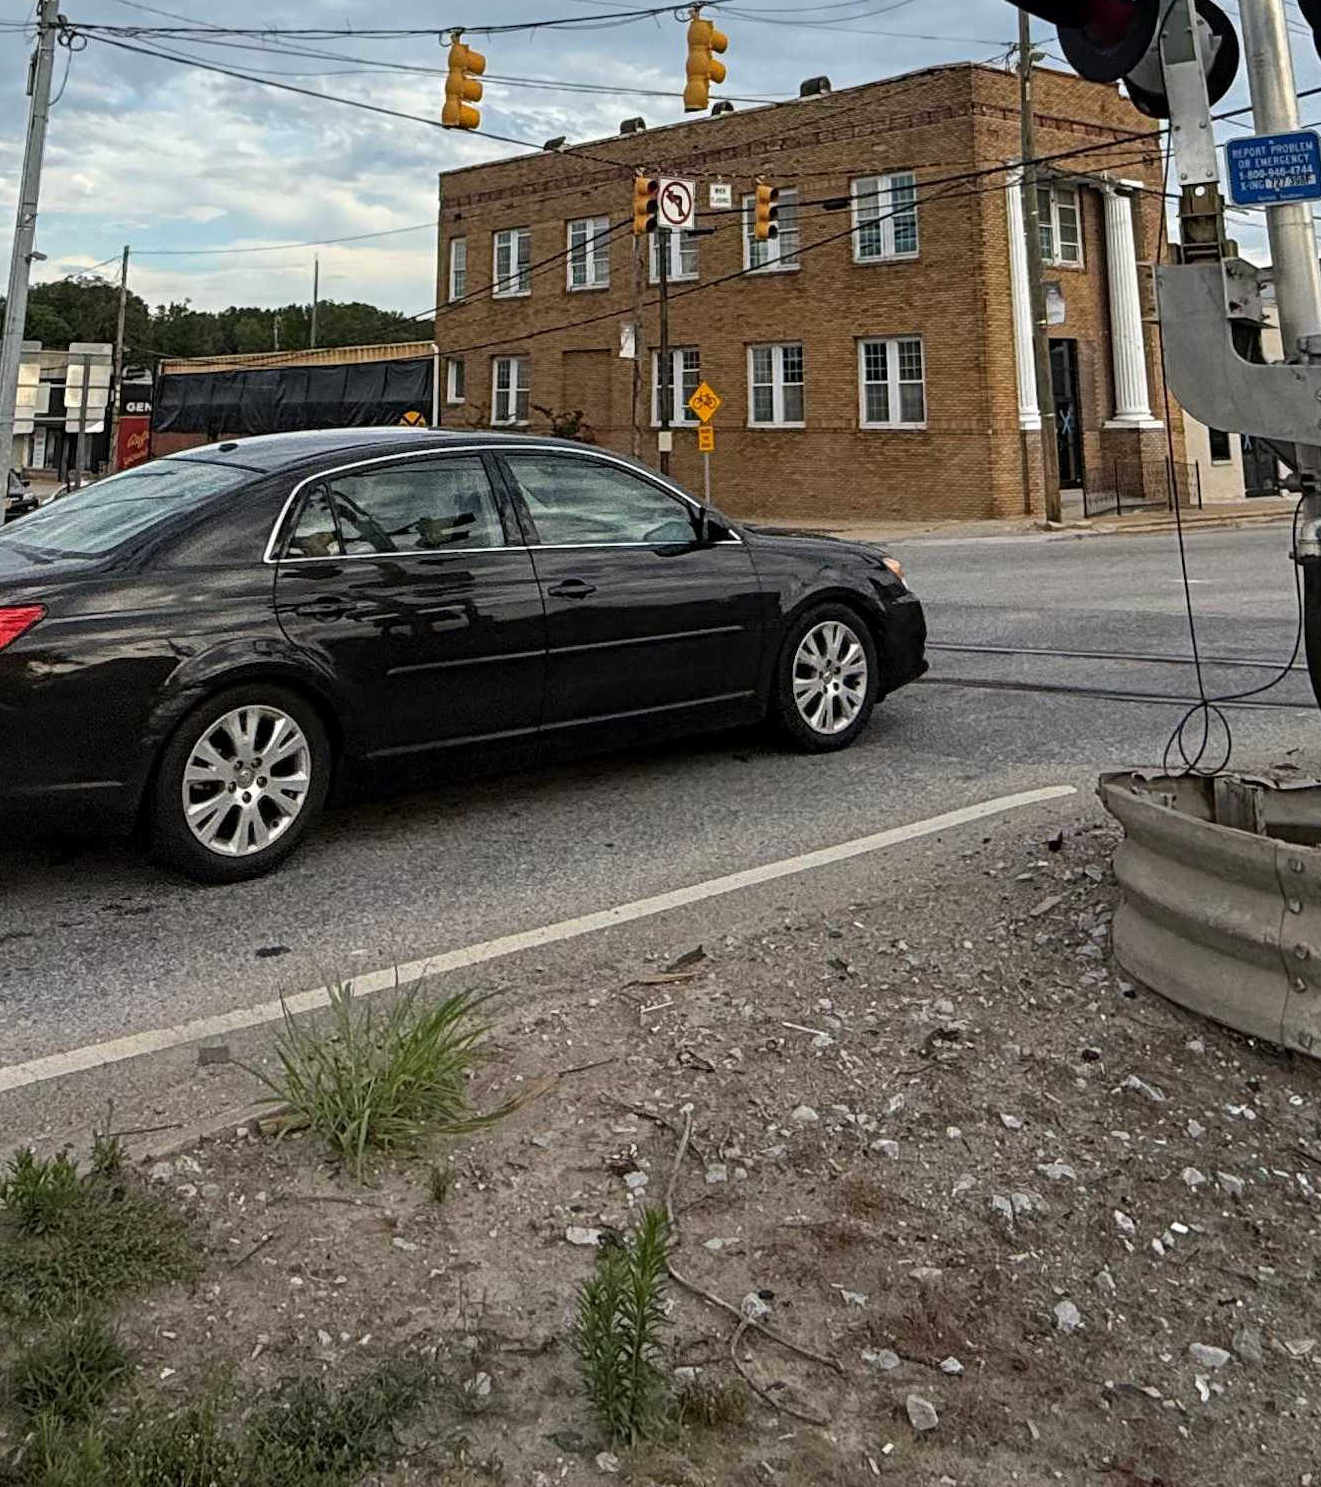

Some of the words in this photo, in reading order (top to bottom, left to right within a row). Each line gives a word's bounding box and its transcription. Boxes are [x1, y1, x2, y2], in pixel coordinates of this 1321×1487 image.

[1231, 145, 1267, 159] REPORT
[1270, 140, 1313, 154] PROBLEM
[1254, 153, 1310, 168] EMERGENCY
